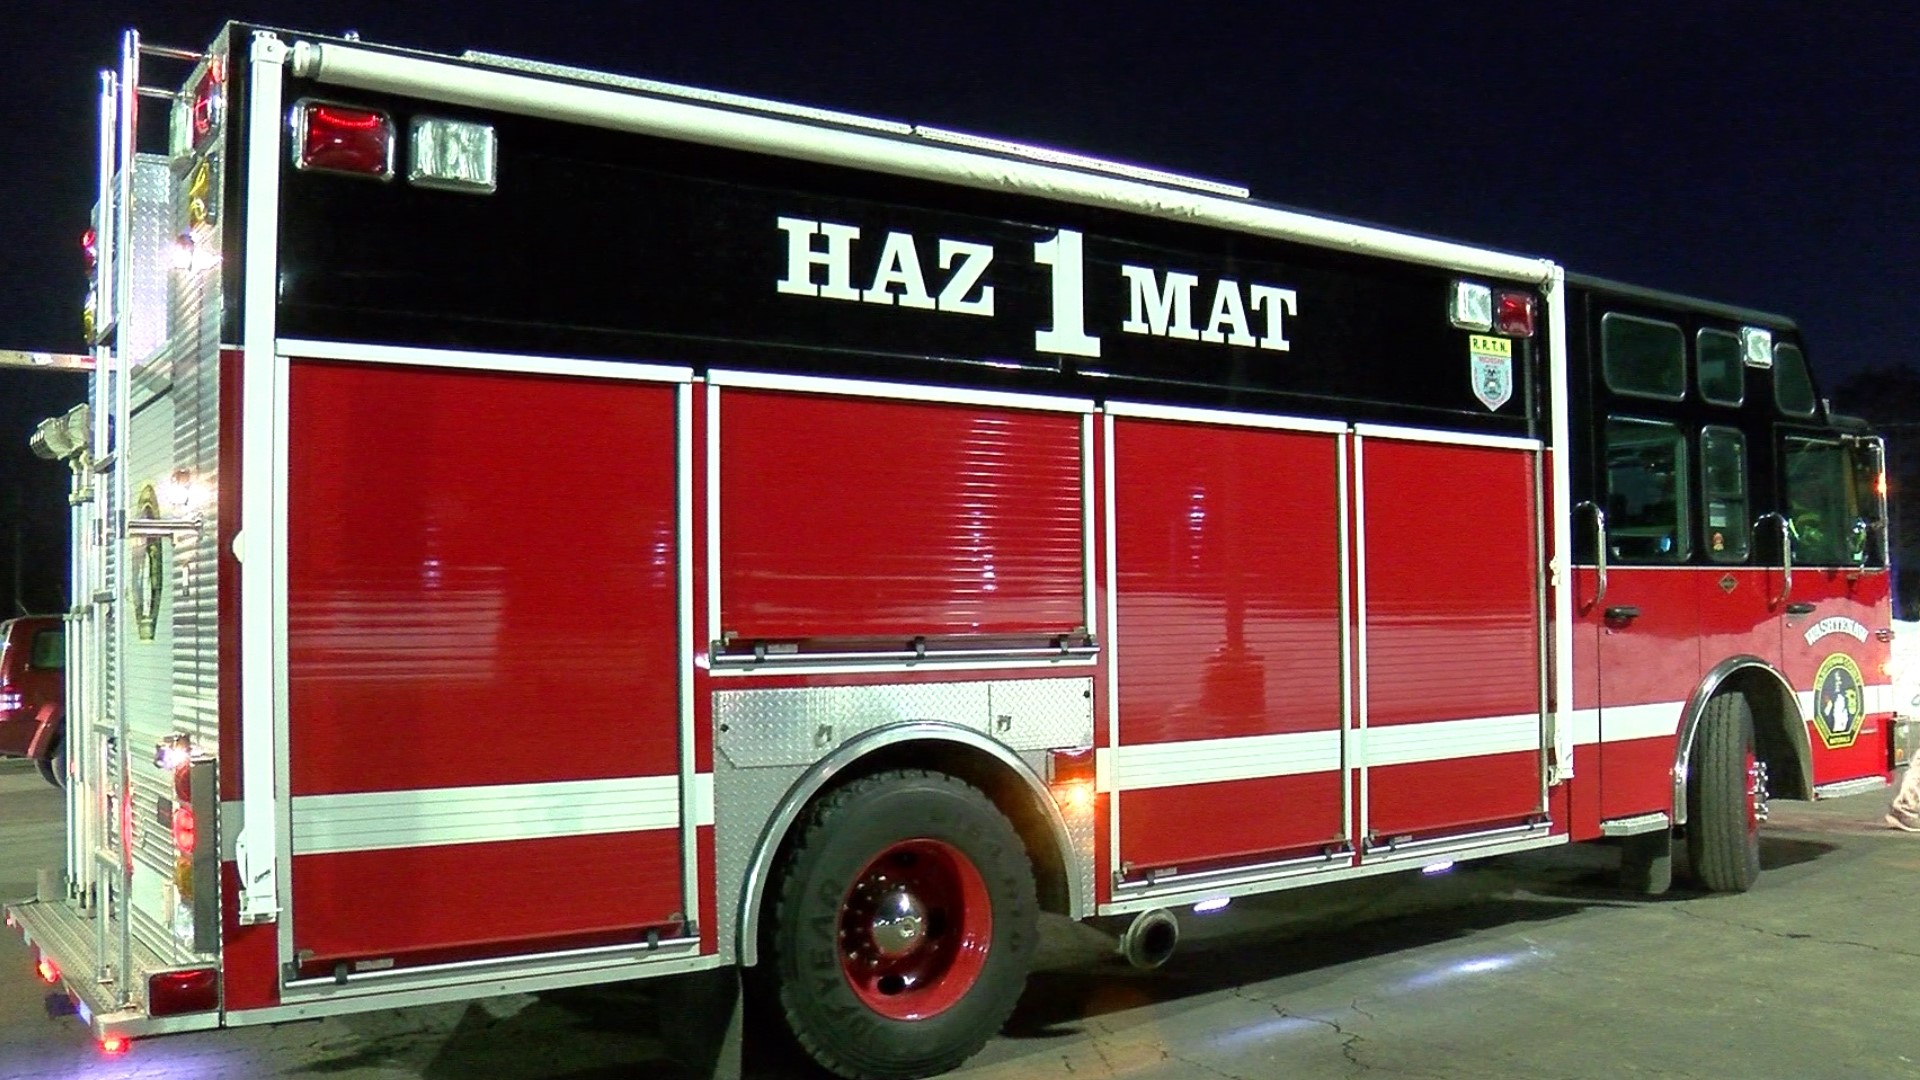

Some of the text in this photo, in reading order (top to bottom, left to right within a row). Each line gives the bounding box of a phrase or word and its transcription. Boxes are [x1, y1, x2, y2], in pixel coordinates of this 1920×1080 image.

[777, 217, 1297, 358] HAZ 1 MAT
